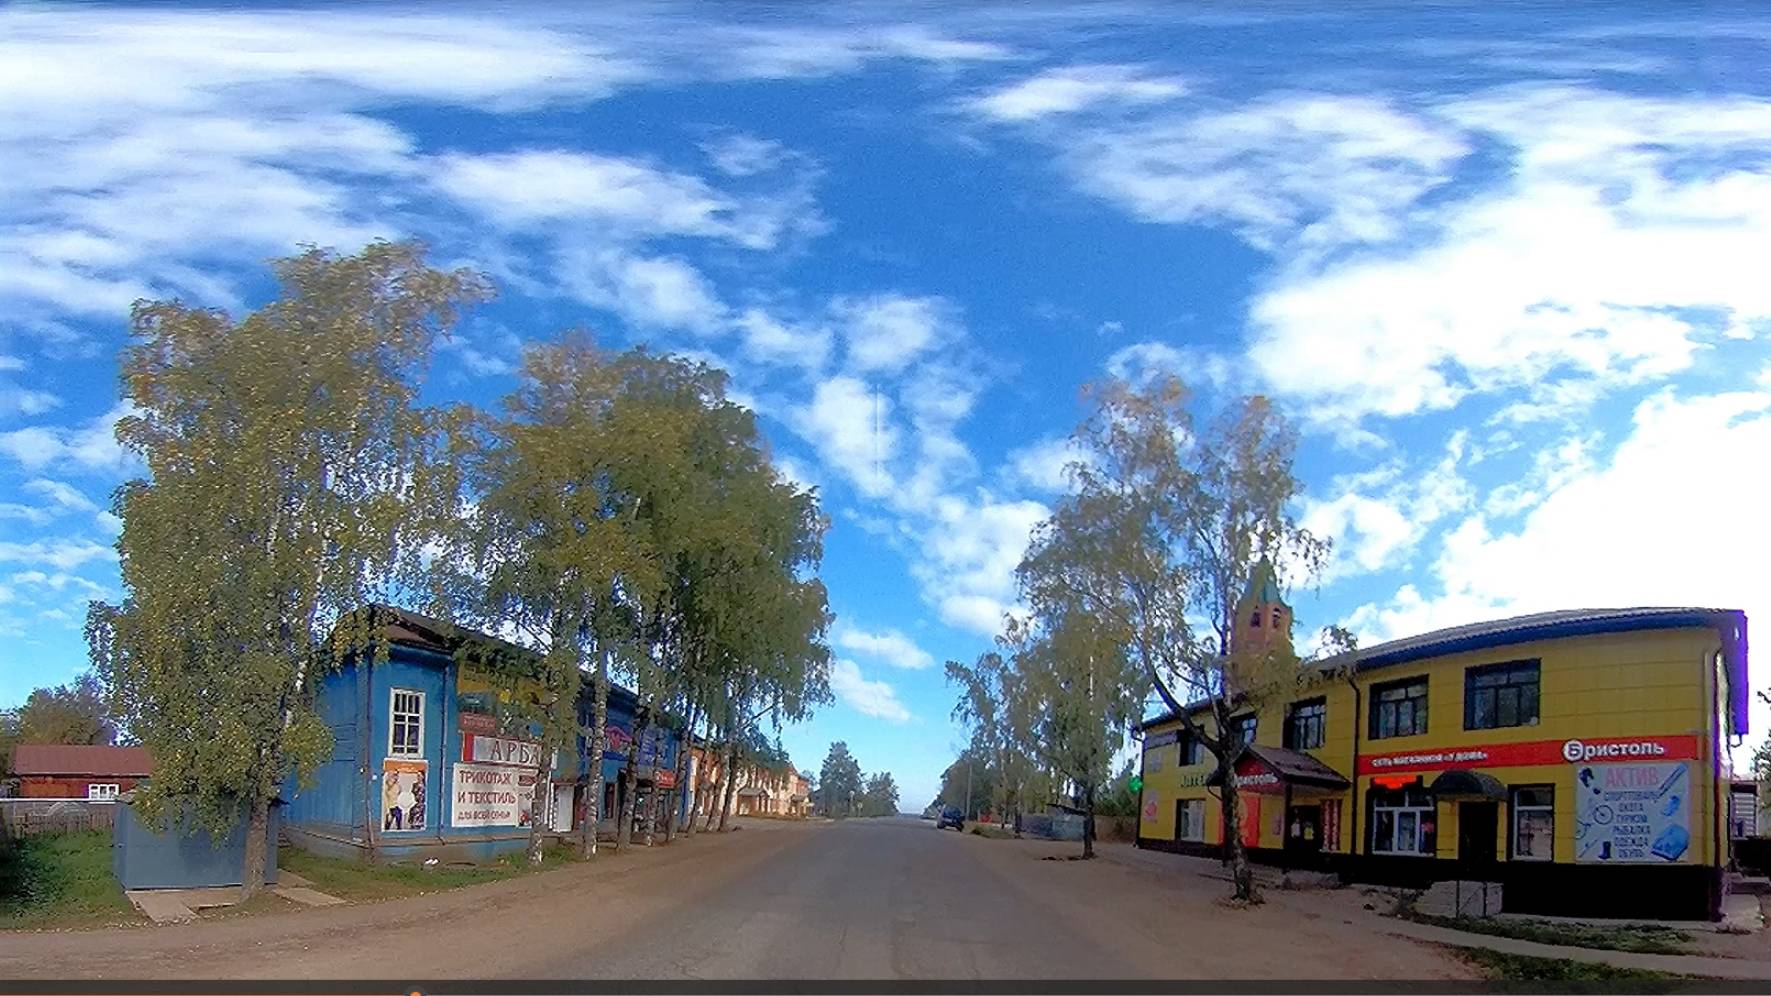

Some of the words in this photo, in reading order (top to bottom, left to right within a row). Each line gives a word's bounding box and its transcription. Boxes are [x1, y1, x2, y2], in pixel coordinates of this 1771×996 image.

[490, 740, 540, 764] АРБА
[1563, 739, 1664, 761] Бристоль
[460, 770, 511, 784] ТРИКОТАЖ
[1233, 772, 1278, 789] ристоль
[1605, 767, 1659, 787] АКТИВ
[458, 792, 465, 803] И
[468, 792, 516, 804] ТЕКСТИЛЬ
